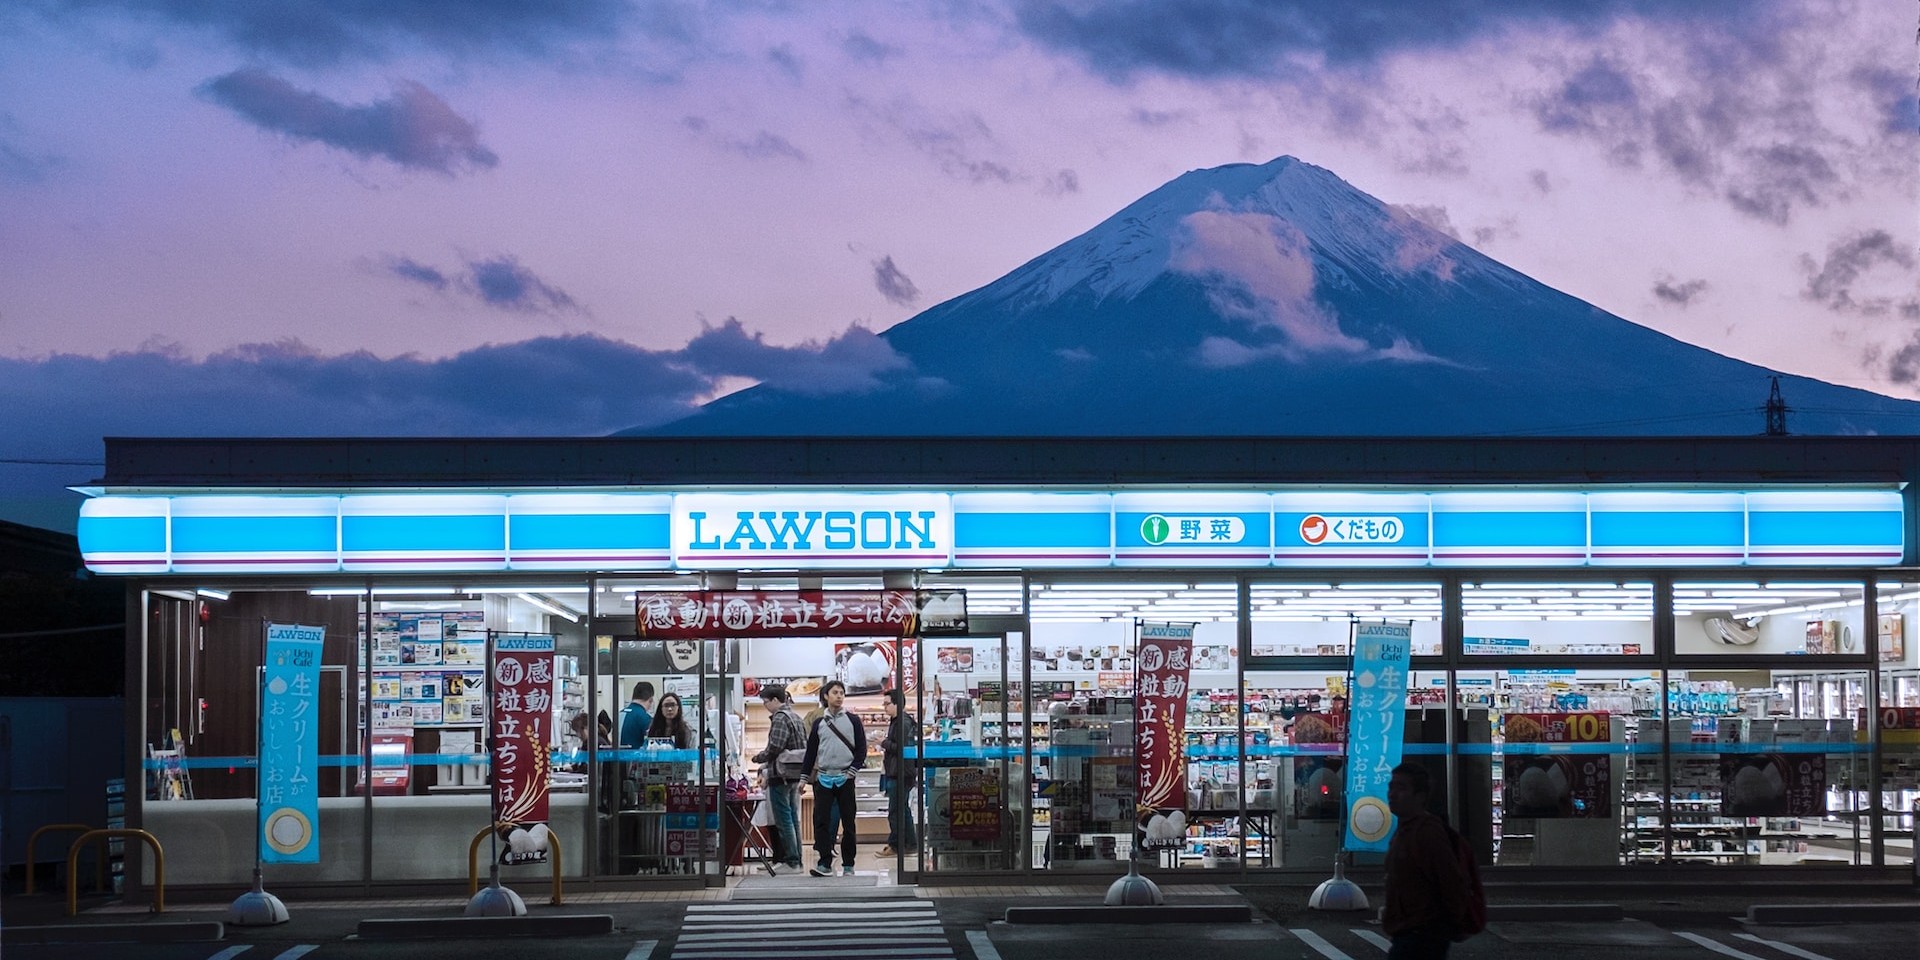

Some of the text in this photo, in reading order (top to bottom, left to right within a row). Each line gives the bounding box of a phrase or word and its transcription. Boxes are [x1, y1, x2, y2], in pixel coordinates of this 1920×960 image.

[689, 511, 935, 550] LAWSON
[1180, 519, 1231, 541] 野菜
[1333, 519, 1397, 540] くだもの
[270, 630, 321, 641] LAWSON
[497, 640, 552, 649] LAWSON
[1143, 627, 1191, 637] LAWSON
[1359, 626, 1409, 637] LAWSON
[294, 649, 313, 658] Uchi
[1381, 644, 1402, 653] Uchi
[1162, 645, 1189, 724] 感動!
[524, 658, 552, 739] 感動!
[290, 672, 313, 795] 生クリームが
[1139, 644, 1163, 806] 新粒立ちごはん
[1374, 666, 1401, 785] 生クリームが
[1565, 714, 1599, 741] 10
[266, 700, 286, 804] おいしいお店
[495, 657, 523, 821] 新粒立ちごはん
[1353, 693, 1374, 792] おいしいお店
[953, 810, 974, 825] 20
